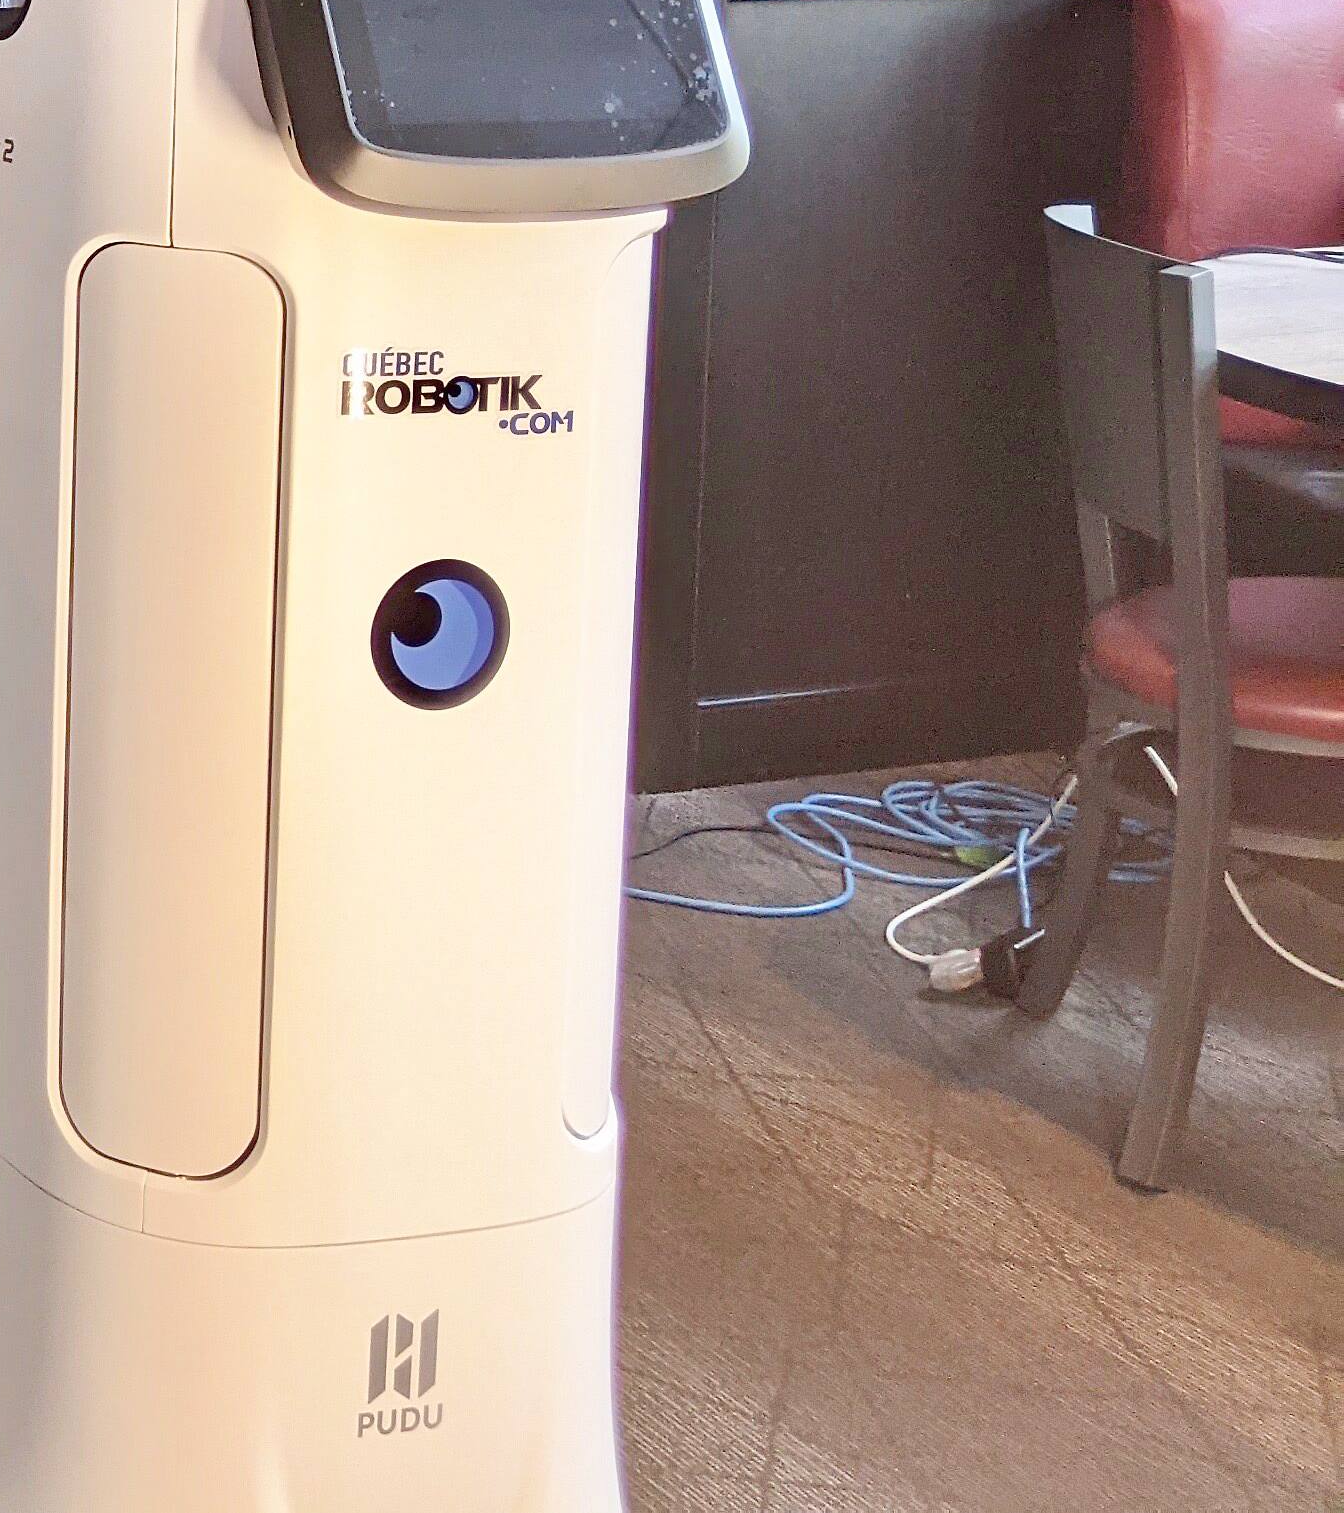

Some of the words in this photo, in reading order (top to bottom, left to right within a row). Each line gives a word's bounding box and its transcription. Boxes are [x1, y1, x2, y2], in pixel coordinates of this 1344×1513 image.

[2, 138, 14, 163] 2
[340, 374, 543, 415] ROBOTIK
[357, 1402, 443, 1438] PUDU
